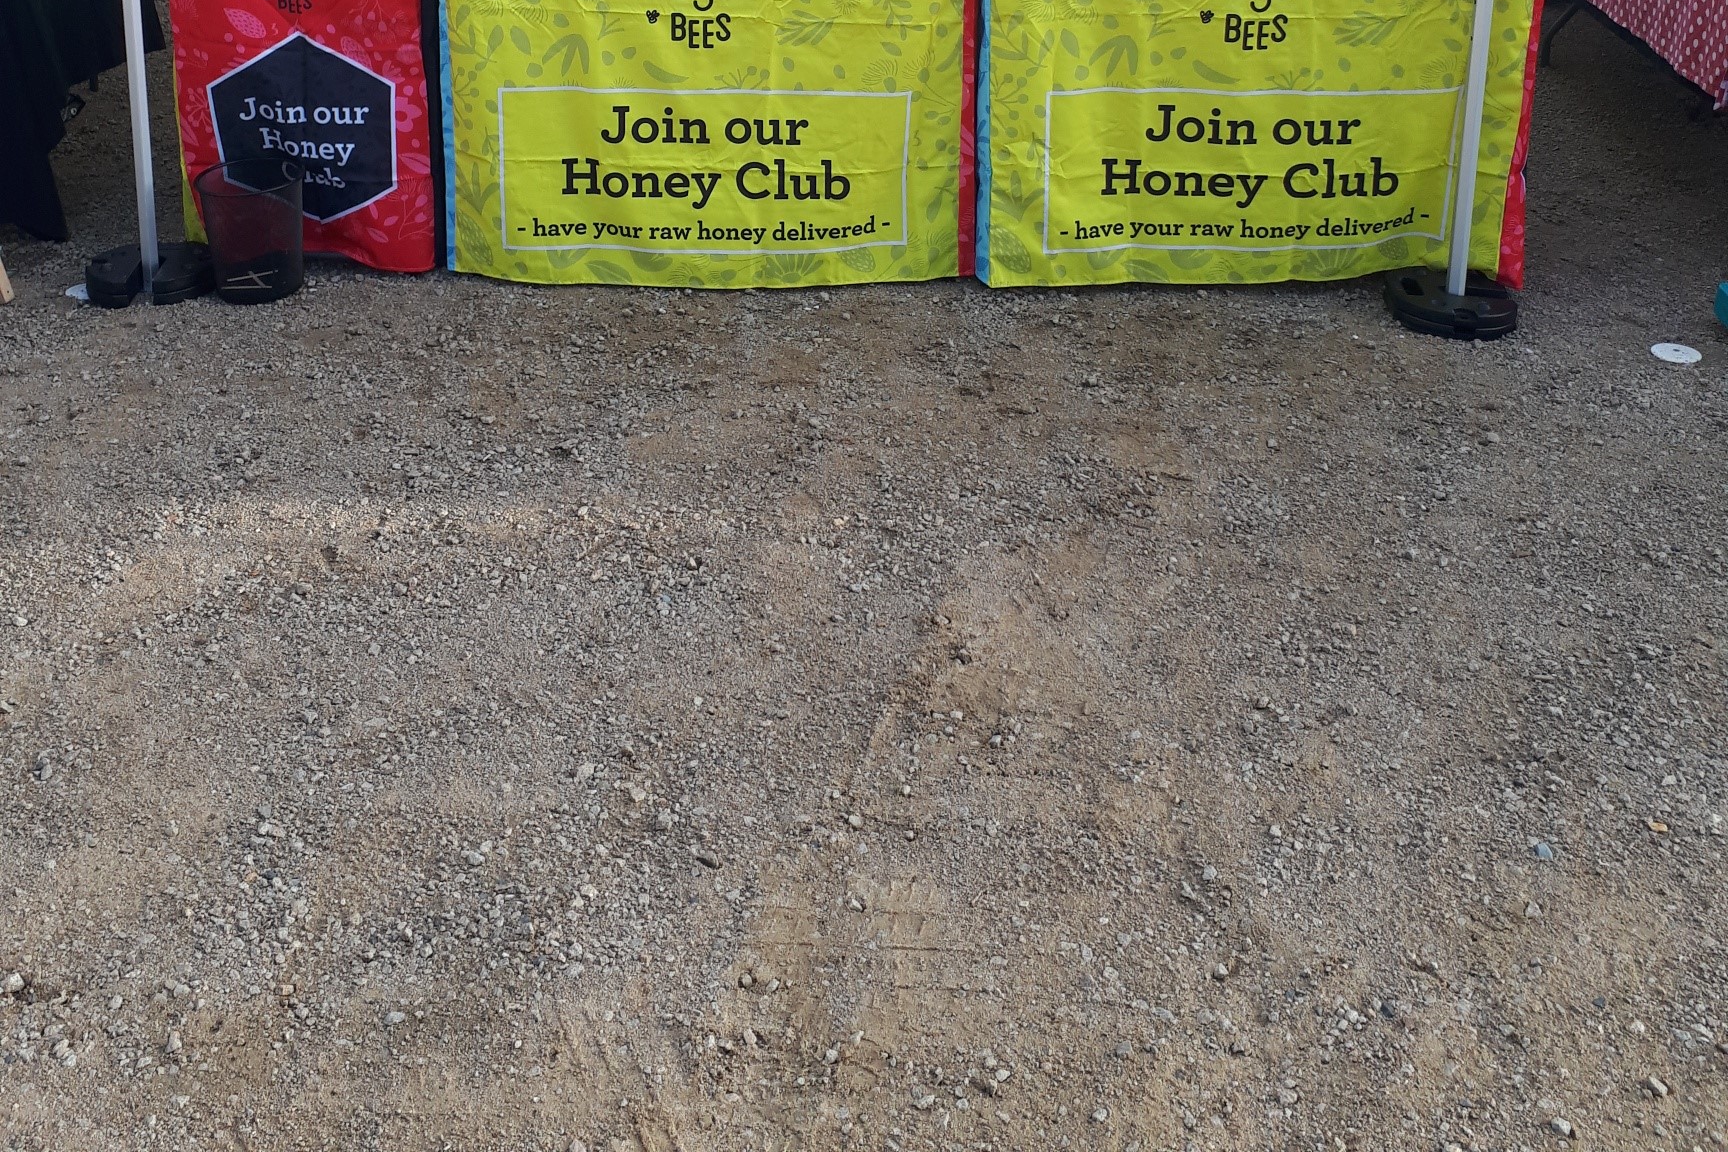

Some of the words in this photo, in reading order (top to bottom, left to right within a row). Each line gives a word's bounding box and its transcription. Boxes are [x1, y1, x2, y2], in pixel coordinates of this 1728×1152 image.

[670, 12, 731, 49] BEES
[1224, 13, 1288, 50] BEES
[239, 97, 307, 124] Join
[313, 106, 369, 125] our
[601, 106, 710, 144] Join
[724, 117, 809, 145] our
[1146, 105, 1257, 145] Join
[1272, 118, 1361, 146] our
[259, 127, 355, 166] Honey
[562, 158, 722, 209] Honey
[736, 159, 851, 200] Club
[1101, 158, 1269, 209] Honey
[1283, 157, 1399, 199] Club
[533, 218, 587, 237] have
[592, 223, 644, 240] your
[649, 226, 692, 241] raw
[697, 219, 767, 244] honey
[772, 214, 876, 241] delivered
[1074, 221, 1125, 240] have
[1130, 221, 1185, 239] your
[1189, 224, 1235, 238] raw
[1239, 219, 1309, 241] honey
[1314, 206, 1416, 237] delivered
